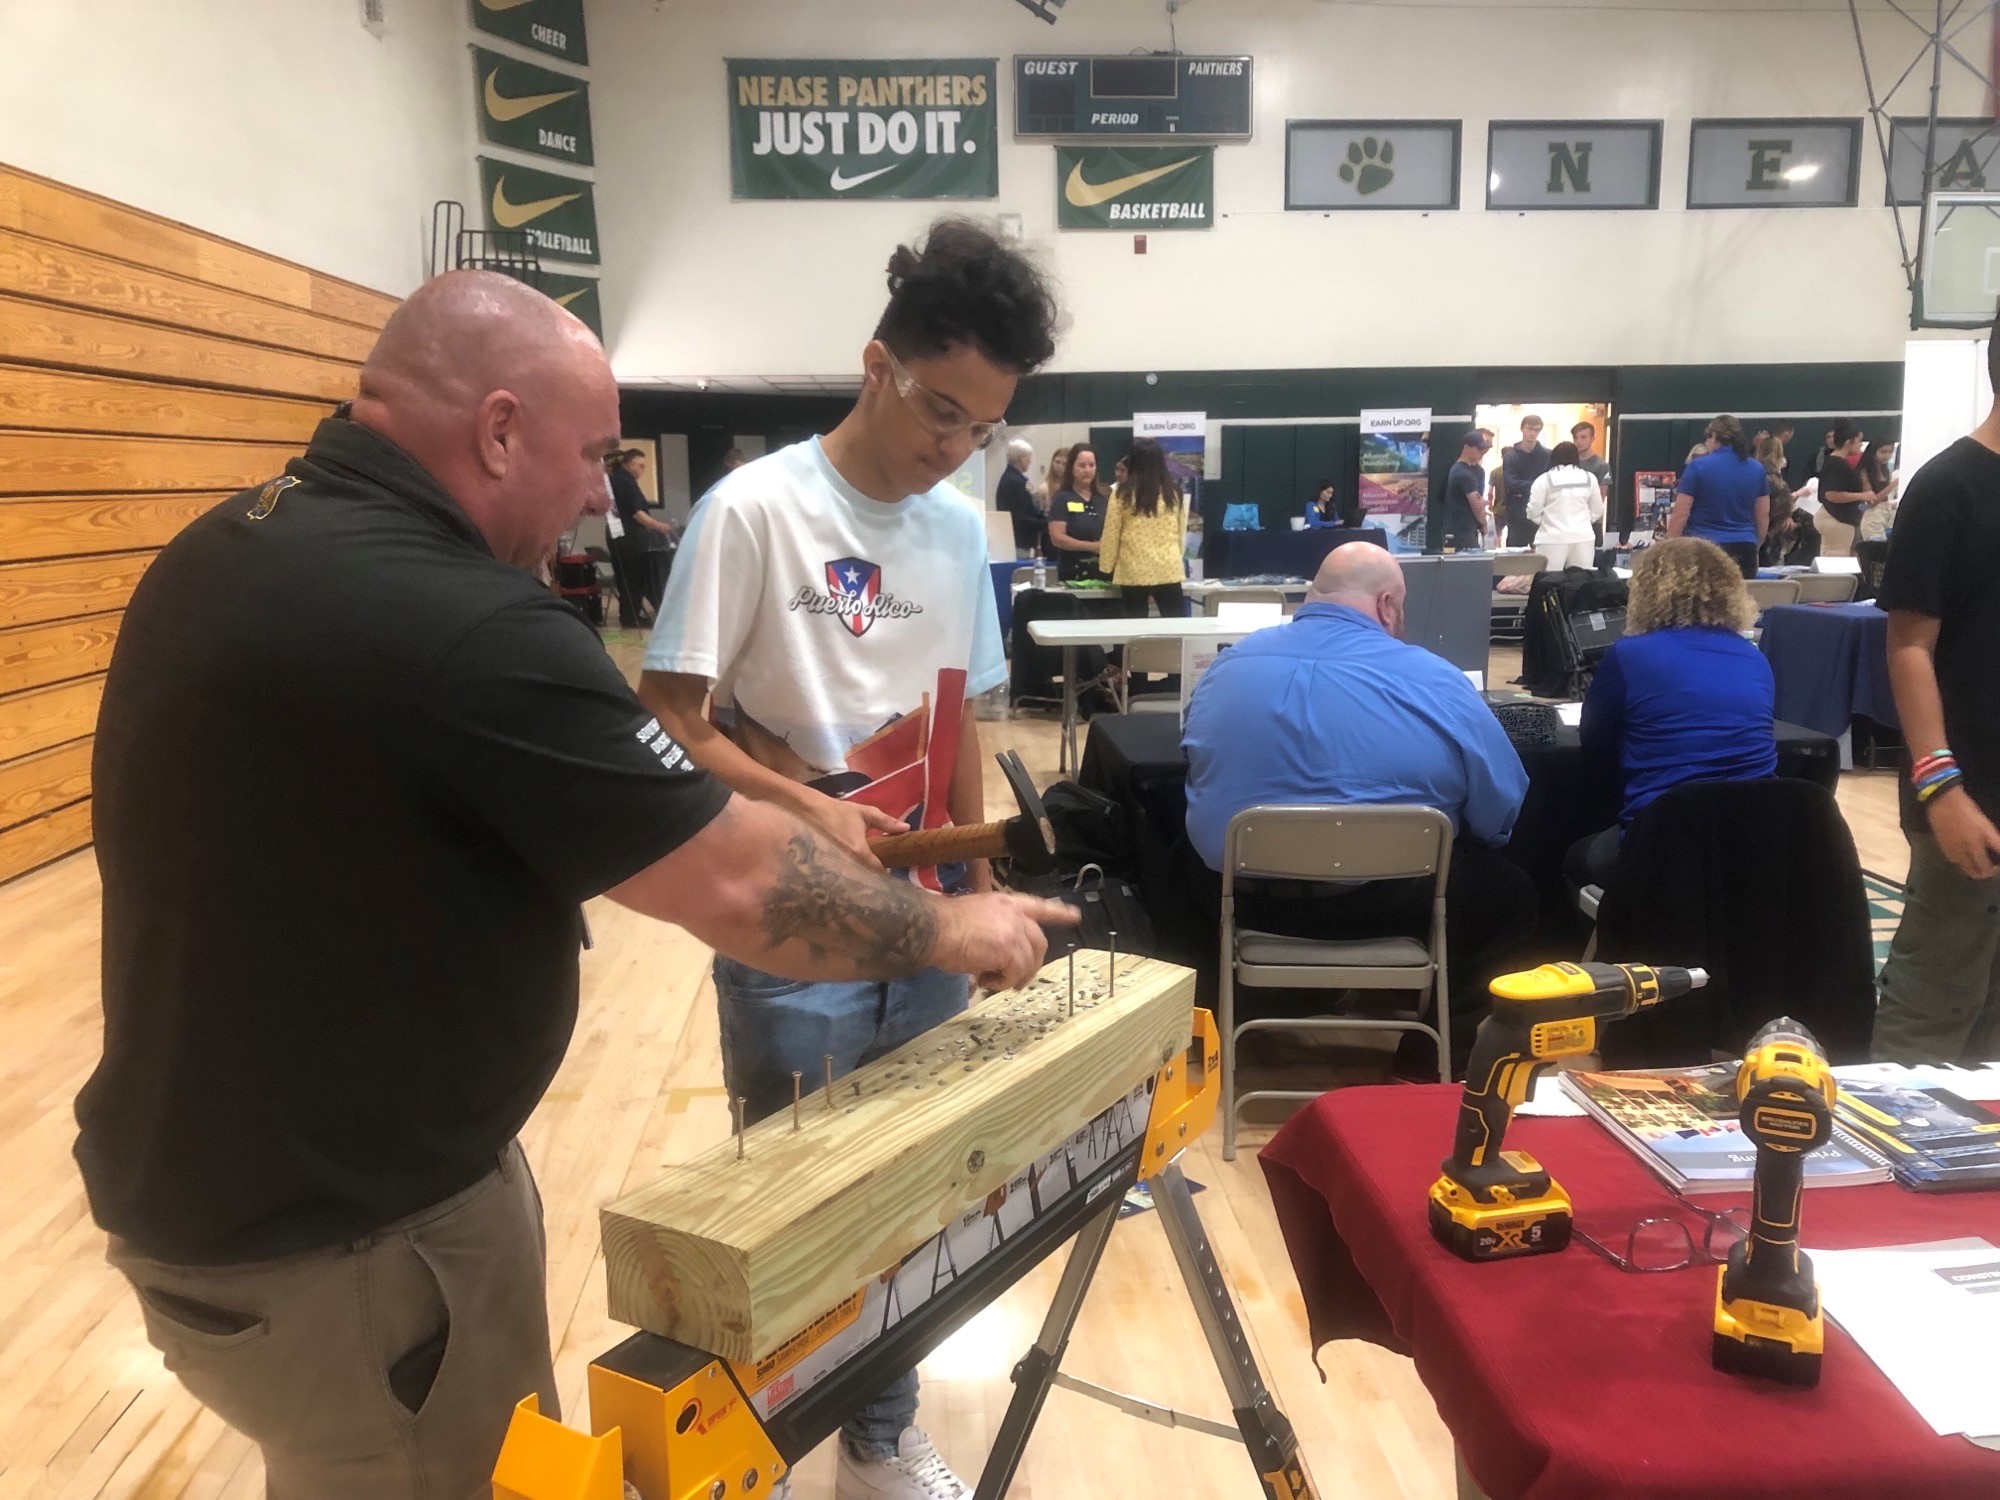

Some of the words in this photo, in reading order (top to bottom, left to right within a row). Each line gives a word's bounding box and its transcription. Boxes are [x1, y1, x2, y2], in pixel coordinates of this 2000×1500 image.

[530, 23, 567, 50] CHEER
[1024, 61, 1079, 75] GUEST
[1187, 62, 1243, 76] PANTHERS
[737, 75, 828, 107] NEASE
[838, 75, 987, 107] PANTHERS
[1090, 113, 1139, 125] PERIOD
[538, 128, 577, 153] DANCE
[752, 110, 850, 155] JUST
[857, 110, 919, 155] DO
[924, 110, 977, 155] IT.
[1547, 141, 1593, 192] N
[1745, 139, 1793, 190] E
[1939, 138, 1987, 189] A
[1109, 202, 1206, 220] BASKETBALL
[788, 583, 863, 616] Puerto
[863, 592, 923, 619] Rico
[1489, 1229, 1532, 1253] XR
[1531, 1225, 1542, 1239] 5
